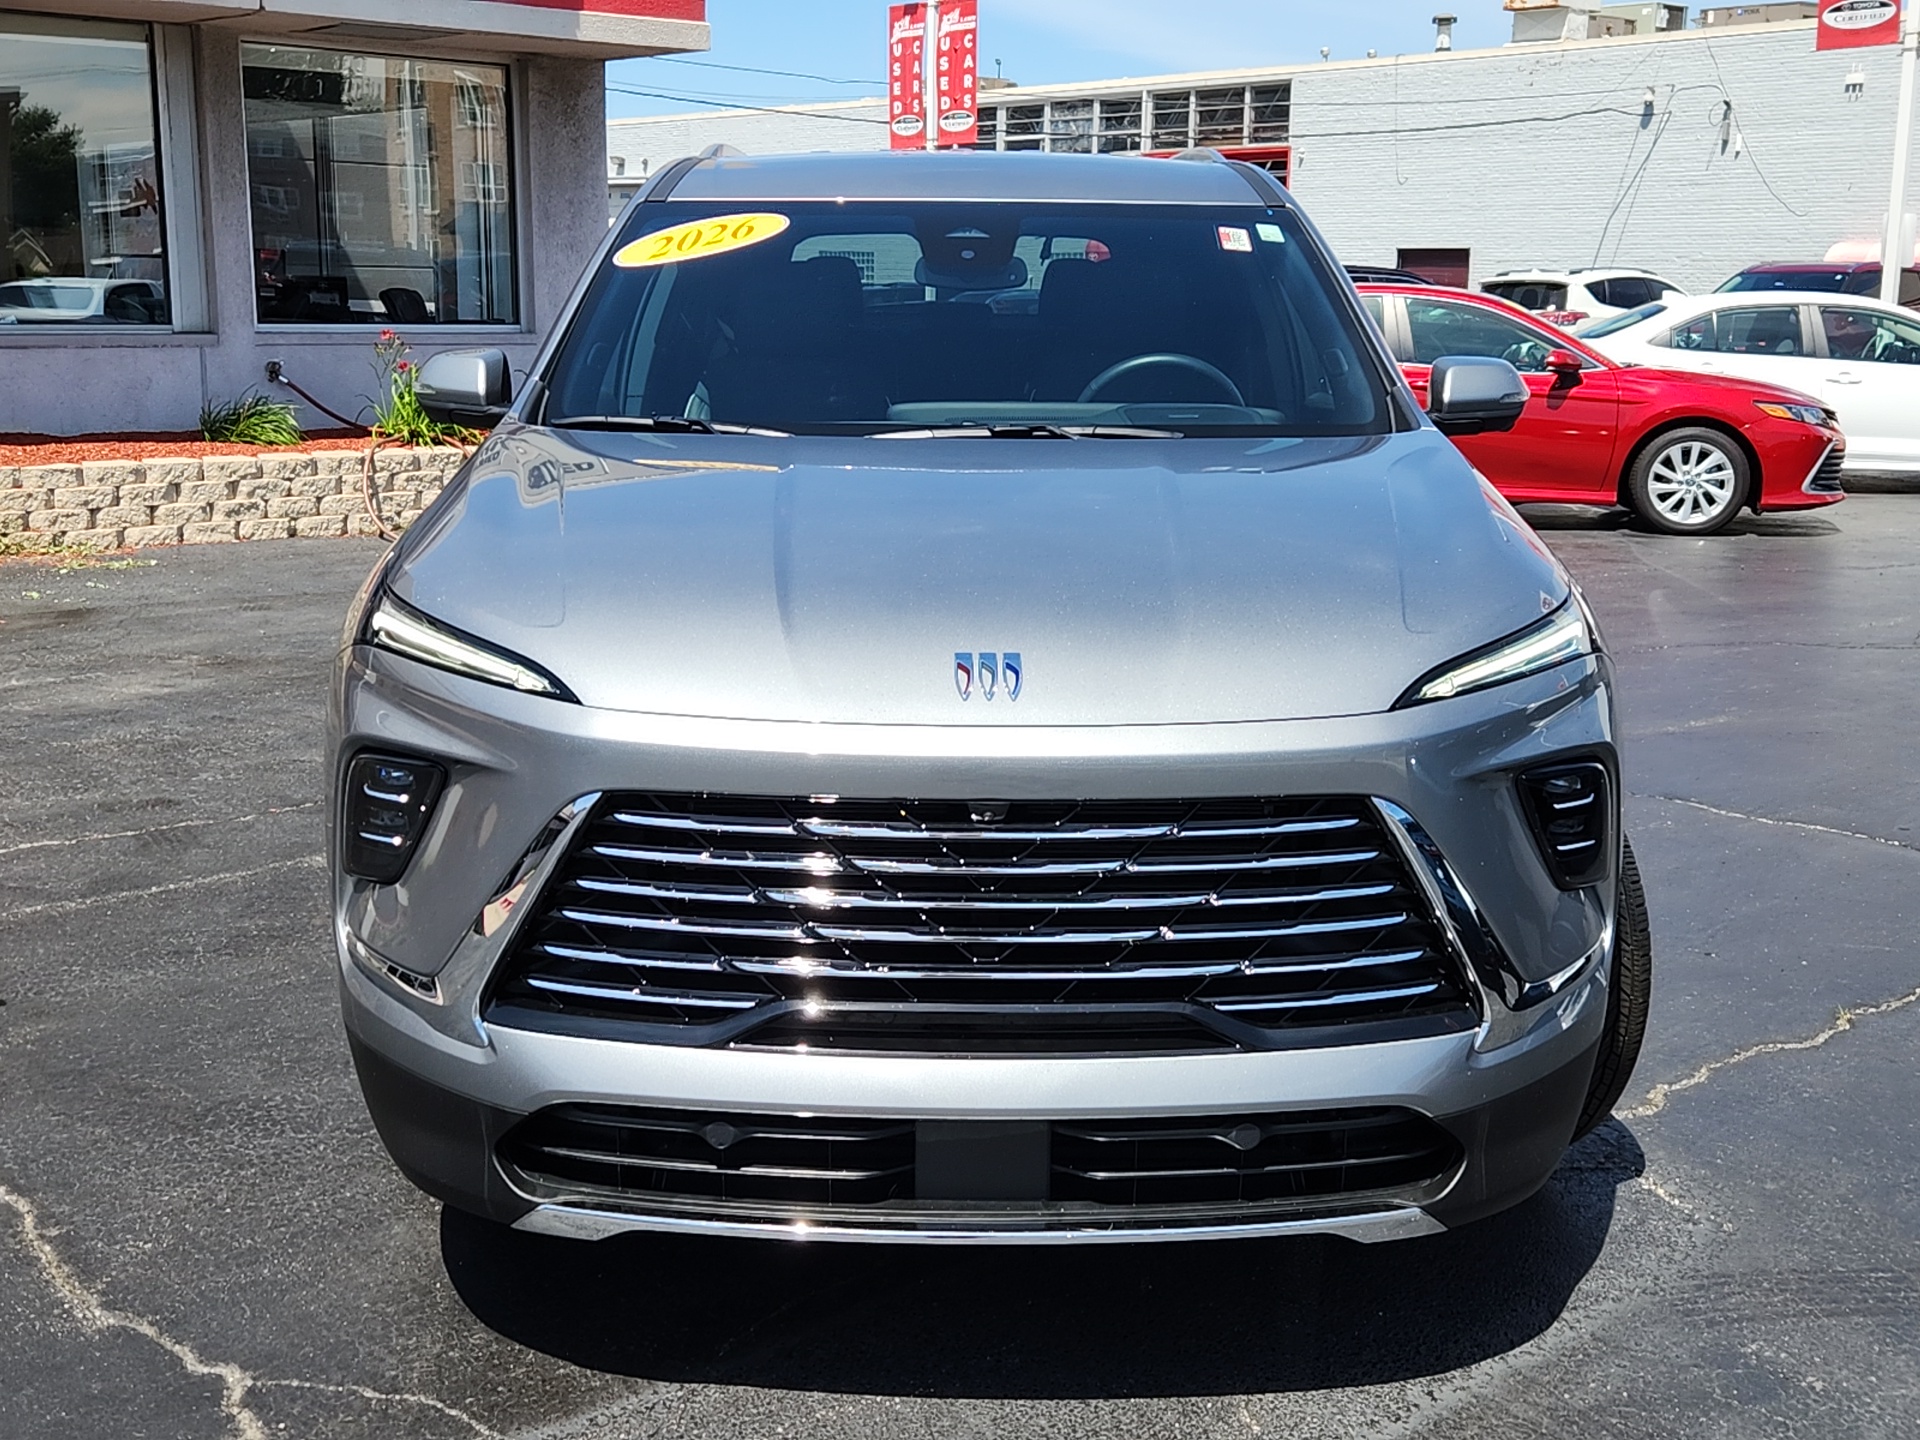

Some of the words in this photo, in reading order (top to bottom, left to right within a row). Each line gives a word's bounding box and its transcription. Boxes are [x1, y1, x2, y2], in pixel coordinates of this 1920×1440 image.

[1834, 12, 1887, 23] CERTIFIED
[1852, 1, 1881, 9] TOYOTA
[892, 42, 903, 115] USED
[912, 40, 921, 113] CARS
[939, 36, 951, 110] USED
[963, 33, 974, 109] CARS
[648, 217, 757, 259] 2026
